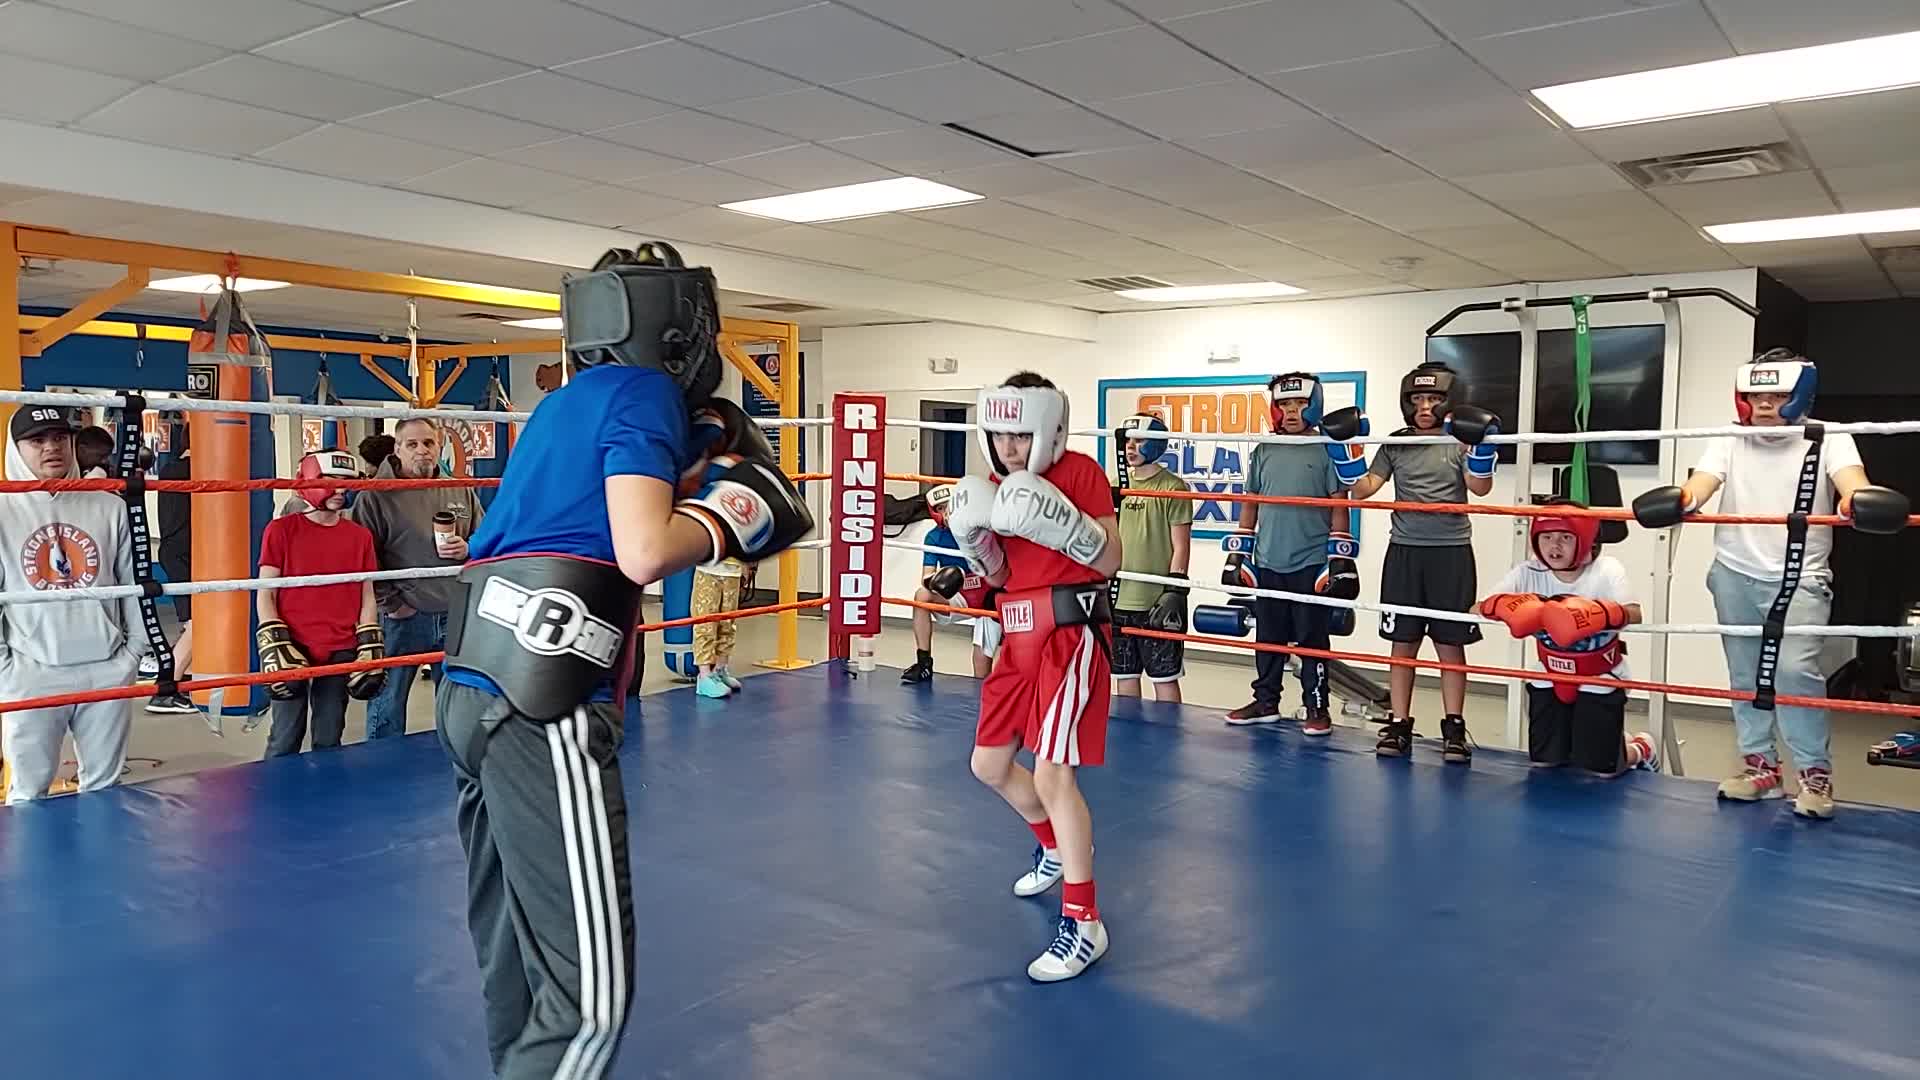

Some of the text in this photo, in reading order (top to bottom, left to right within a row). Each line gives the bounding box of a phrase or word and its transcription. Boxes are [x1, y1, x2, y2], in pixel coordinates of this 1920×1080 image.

[1281, 380, 1301, 391] USA
[1751, 371, 1778, 384] USA
[31, 408, 60, 421] SIB
[1137, 390, 1273, 434] STRON
[934, 488, 950, 499] USA
[840, 403, 877, 625] RINGSIDE
[1000, 487, 1072, 526] VENUM
[23, 526, 97, 576] STRONG ISLAND
[1004, 605, 1029, 626] TITLE
[1550, 658, 1573, 670] TITLE
[263, 652, 294, 699] VEUM
